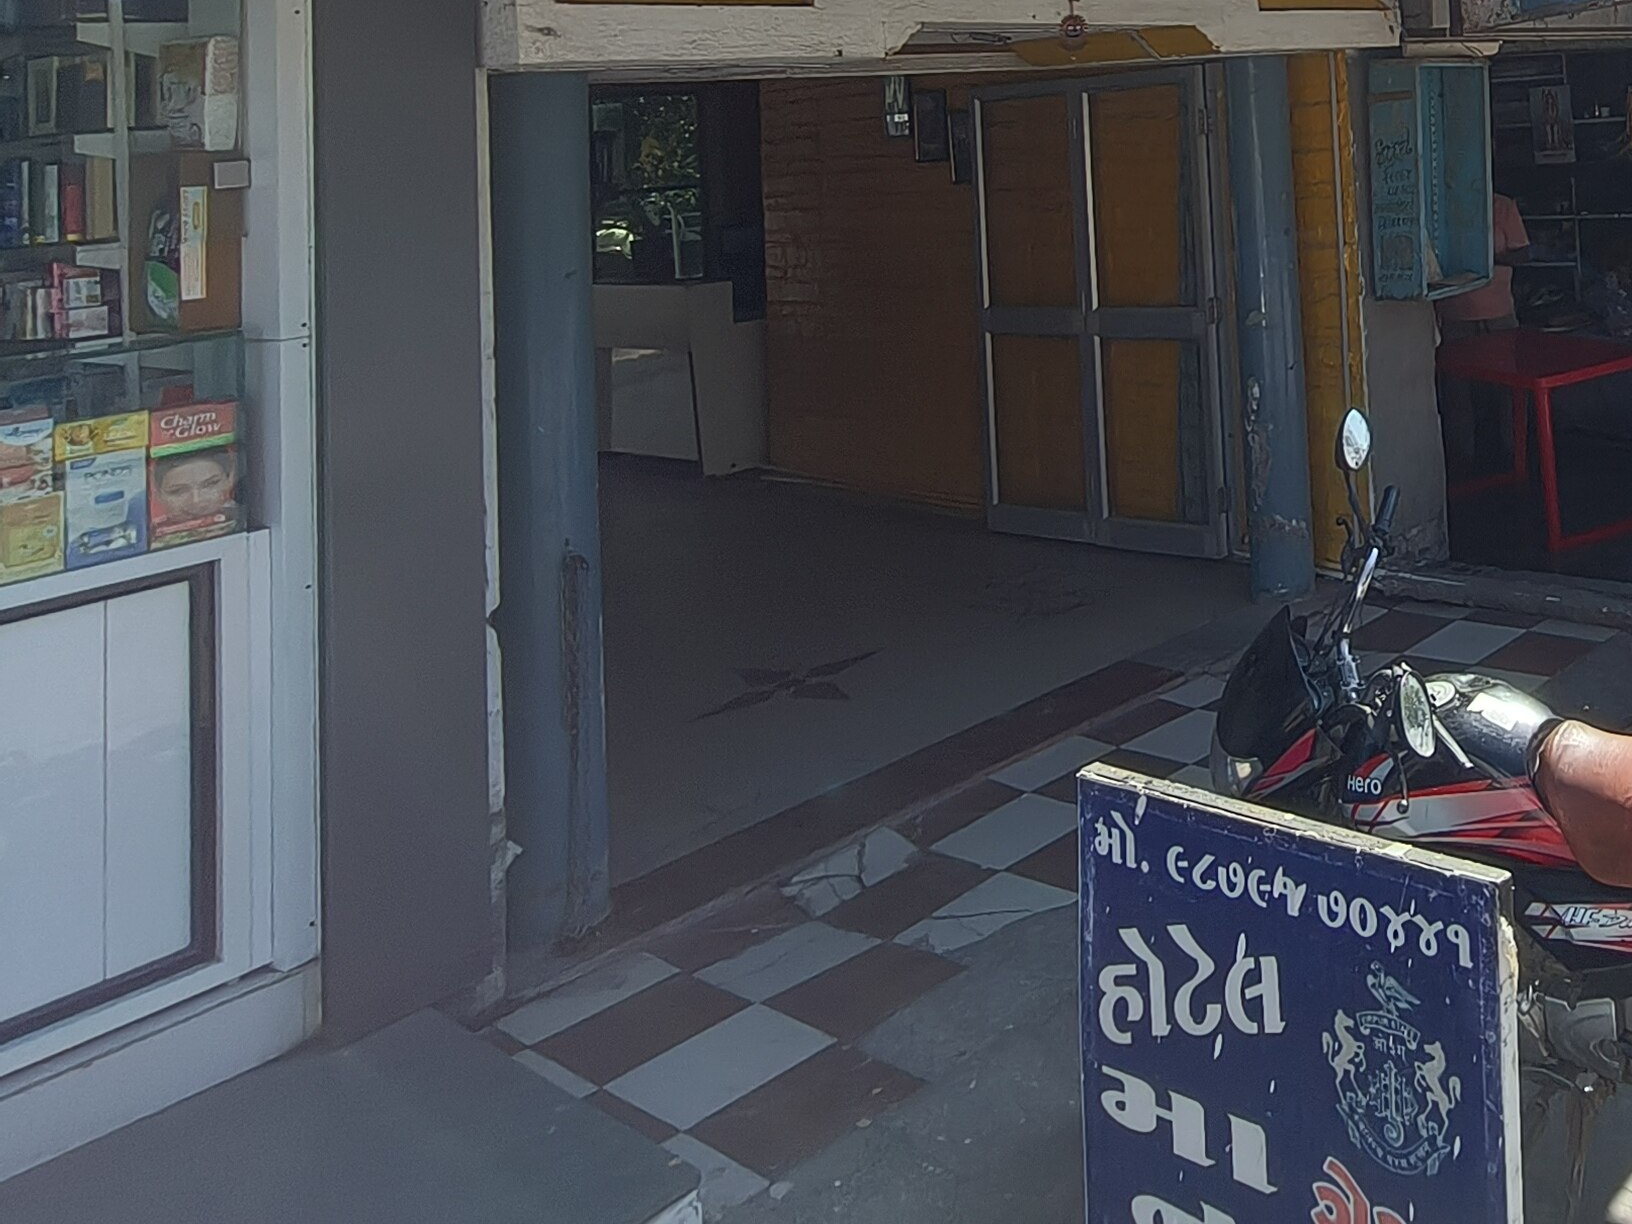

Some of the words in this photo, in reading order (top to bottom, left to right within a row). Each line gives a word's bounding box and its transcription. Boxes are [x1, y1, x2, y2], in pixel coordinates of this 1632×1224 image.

[160, 412, 217, 429] Charm
[175, 423, 221, 438] Glow
[1347, 774, 1382, 795] Hero
[1094, 809, 1150, 874] મો.
